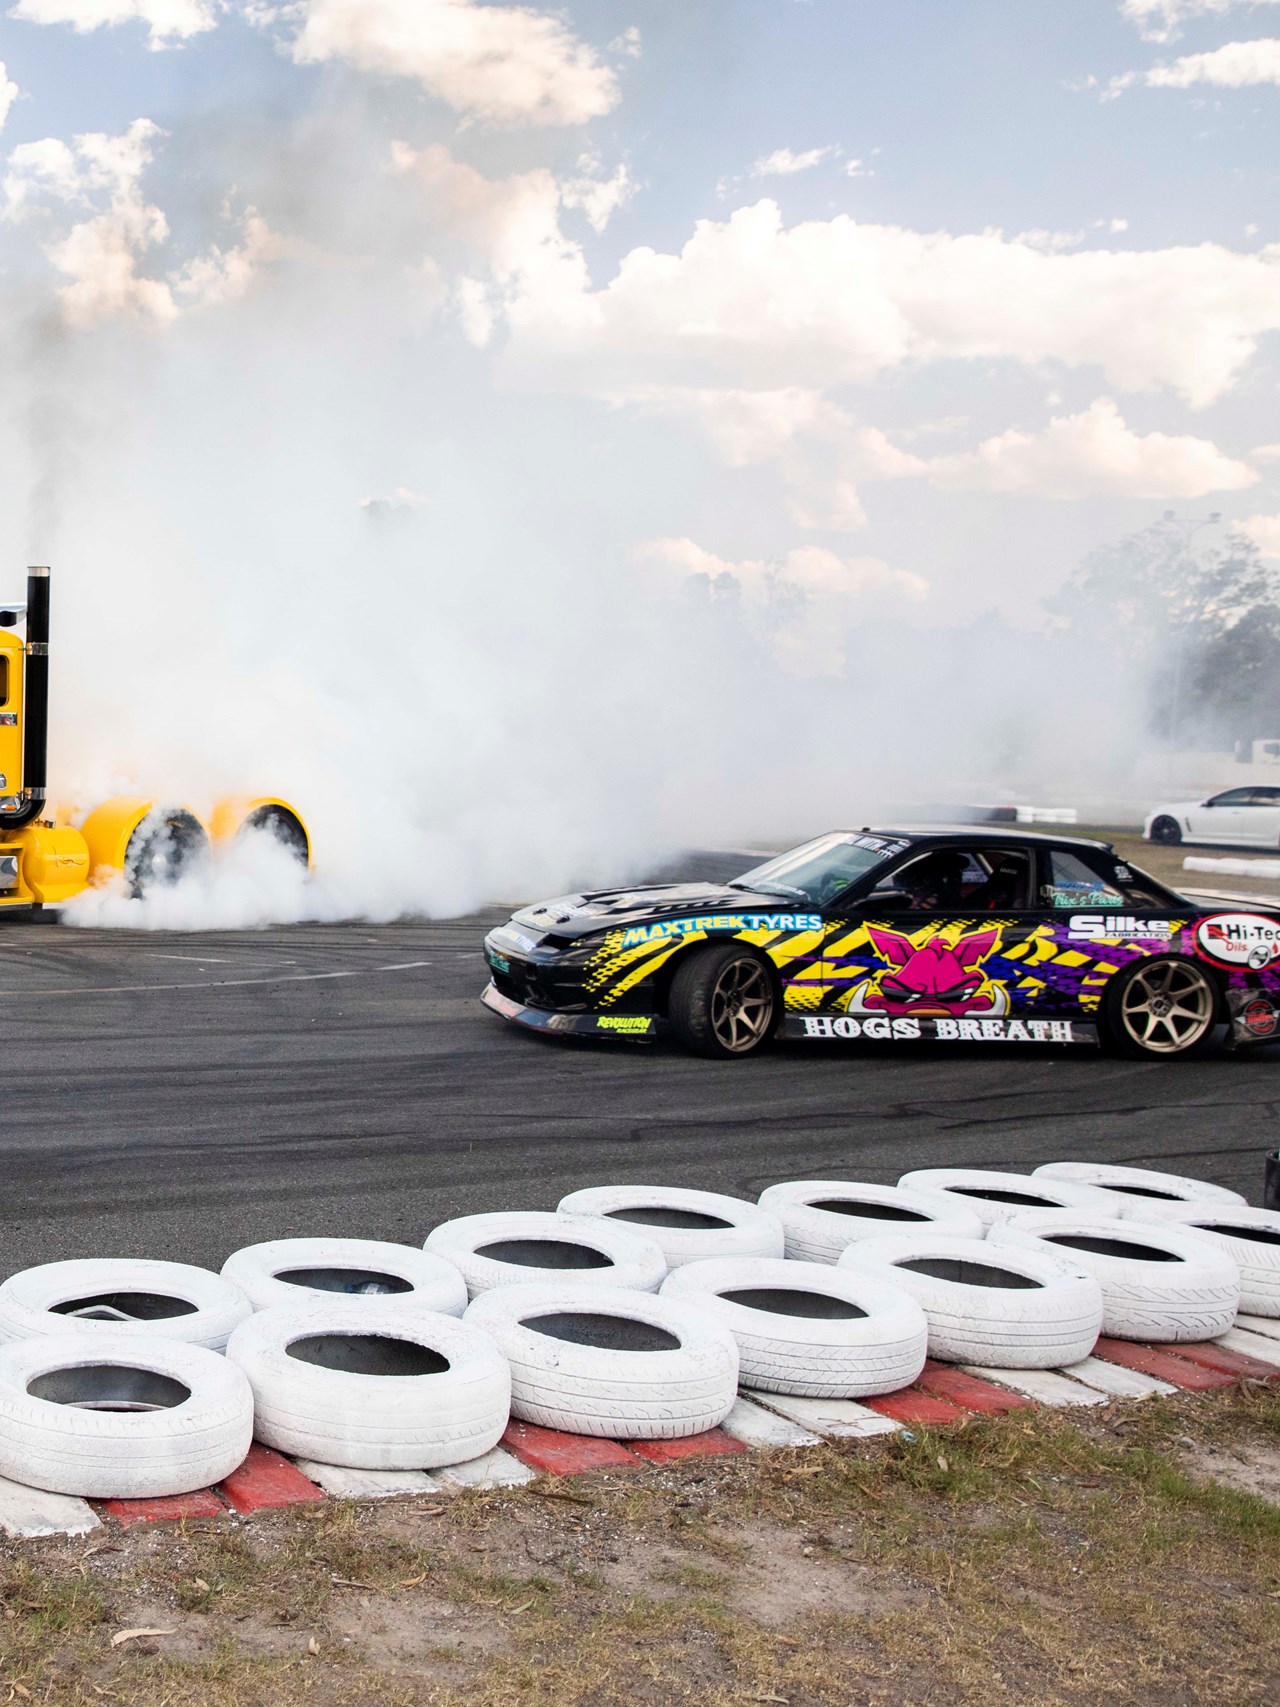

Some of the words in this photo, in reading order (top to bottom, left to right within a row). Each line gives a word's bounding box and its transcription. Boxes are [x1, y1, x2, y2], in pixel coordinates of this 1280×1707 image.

[623, 916, 746, 945] MAXTREK
[750, 914, 822, 931] TYRES
[1068, 915, 1170, 939] Silke
[1226, 942, 1247, 951] Oils
[597, 1016, 652, 1029] REVOLUTION
[799, 1016, 922, 1040] HOGS
[933, 1018, 1075, 1043] BREATH
